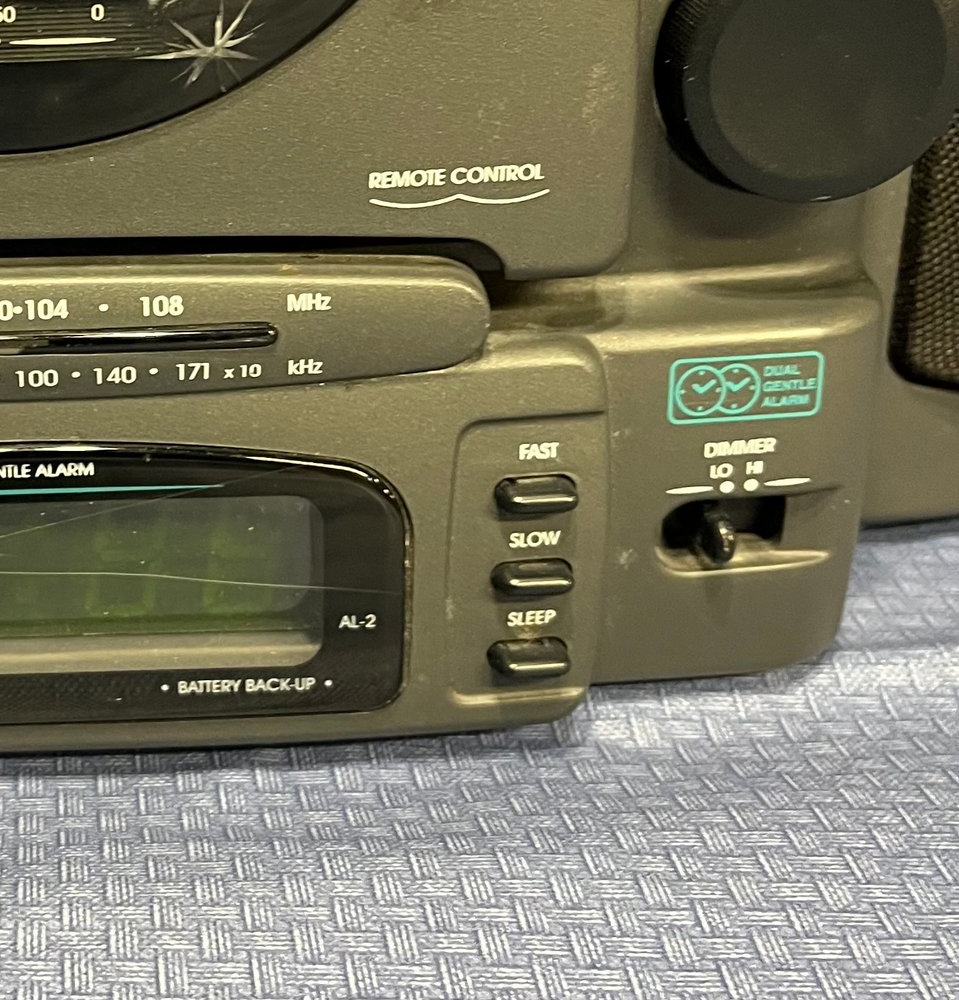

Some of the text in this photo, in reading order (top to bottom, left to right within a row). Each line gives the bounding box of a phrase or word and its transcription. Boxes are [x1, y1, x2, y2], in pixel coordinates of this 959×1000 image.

[91, 4, 104, 20] 0
[369, 164, 544, 188] REMOTE CONTROL
[140, 295, 184, 316] 108
[287, 293, 331, 311] MHz
[15, 370, 58, 387] 100
[94, 367, 136, 384] 140
[176, 363, 209, 380] 171
[288, 359, 323, 374] kHz
[764, 365, 800, 376] DUAL
[763, 378, 817, 392] GENTLE
[761, 395, 809, 406] ALARM
[519, 442, 559, 460] FAST
[703, 437, 778, 458] DIMMER
[35, 463, 94, 477] ALARM
[709, 461, 763, 480] LO HI
[509, 531, 561, 548] SLOW
[339, 614, 376, 628] AL-2
[508, 610, 556, 626] SLEEP
[178, 678, 315, 693] BATTERY BACK-UP
